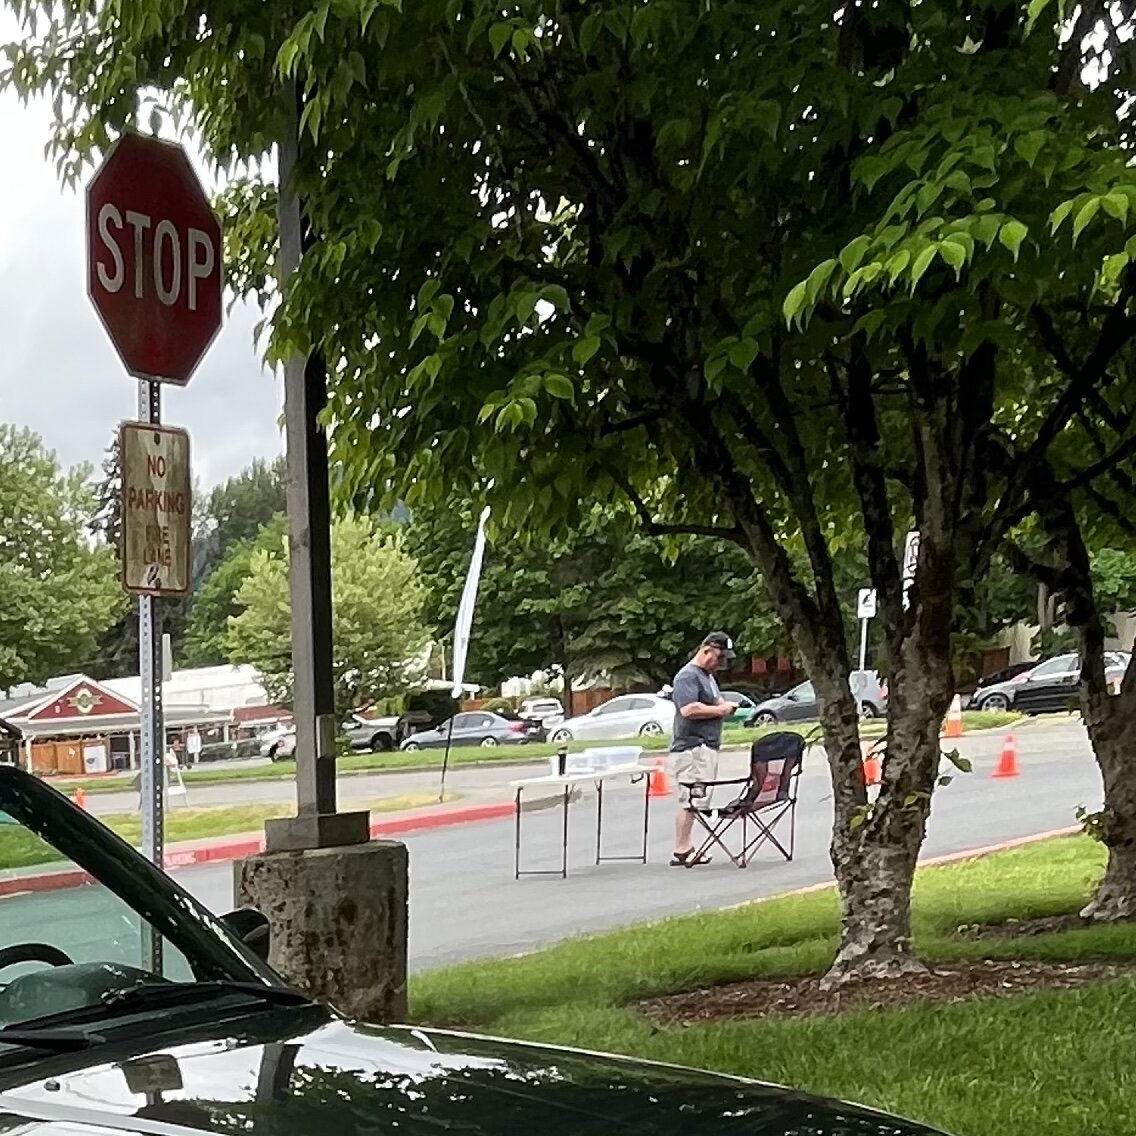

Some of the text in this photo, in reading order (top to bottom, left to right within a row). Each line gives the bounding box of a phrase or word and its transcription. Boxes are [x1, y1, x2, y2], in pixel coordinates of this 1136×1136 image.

[97, 203, 214, 310] STOP
[147, 454, 167, 479] NO
[128, 487, 185, 515] PARKING
